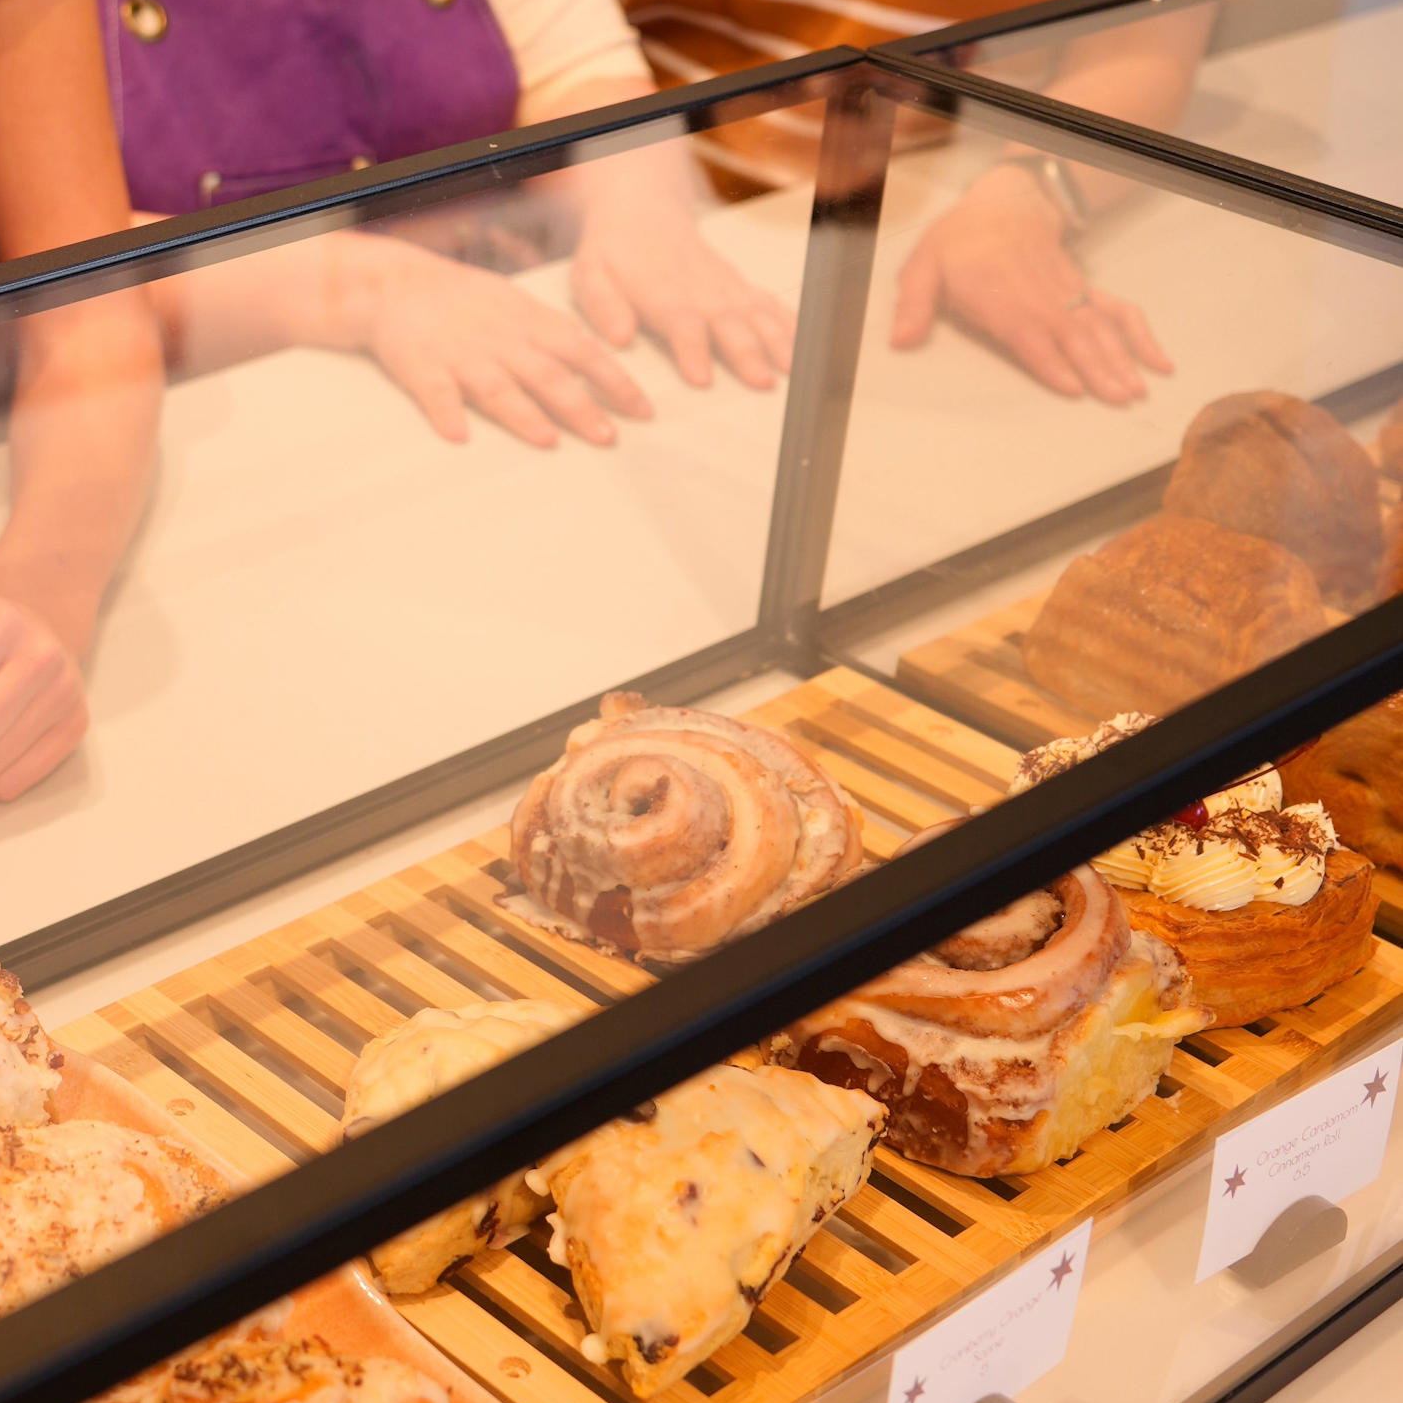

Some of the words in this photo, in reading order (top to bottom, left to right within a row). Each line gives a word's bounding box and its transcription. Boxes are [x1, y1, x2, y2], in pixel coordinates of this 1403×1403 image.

[1256, 1137, 1299, 1166] Orange
[1268, 1143, 1320, 1177] Cinnamon
[1323, 1127, 1342, 1148] Roll
